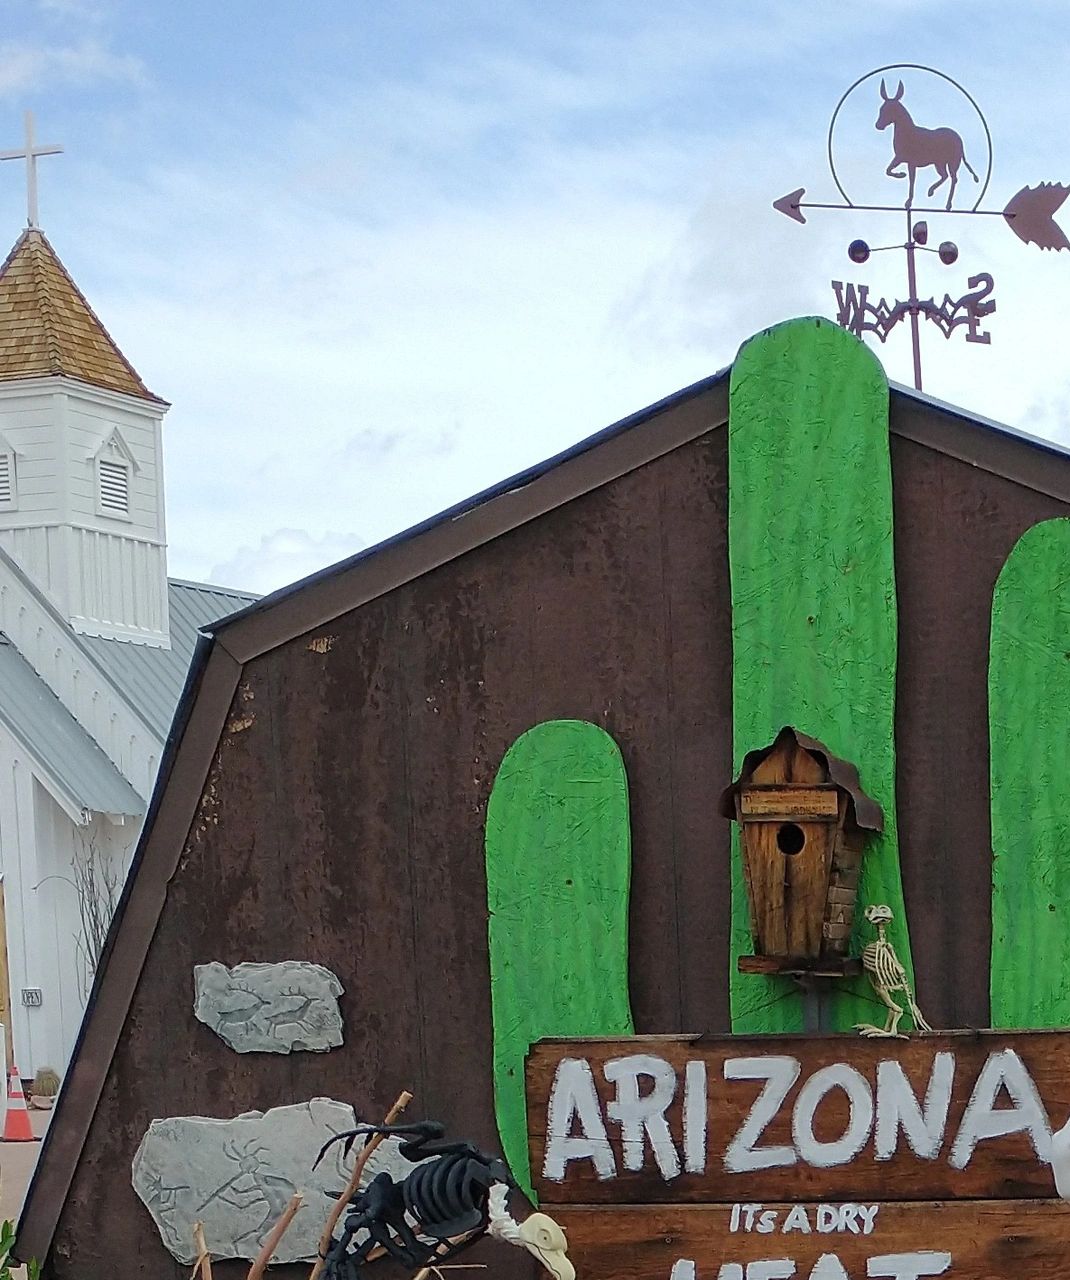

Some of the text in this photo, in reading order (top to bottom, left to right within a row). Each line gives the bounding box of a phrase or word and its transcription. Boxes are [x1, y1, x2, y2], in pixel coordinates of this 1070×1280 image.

[541, 1048, 1052, 1183] ARIZONA
[782, 1204, 812, 1234] A
[817, 1203, 879, 1235] DRY
